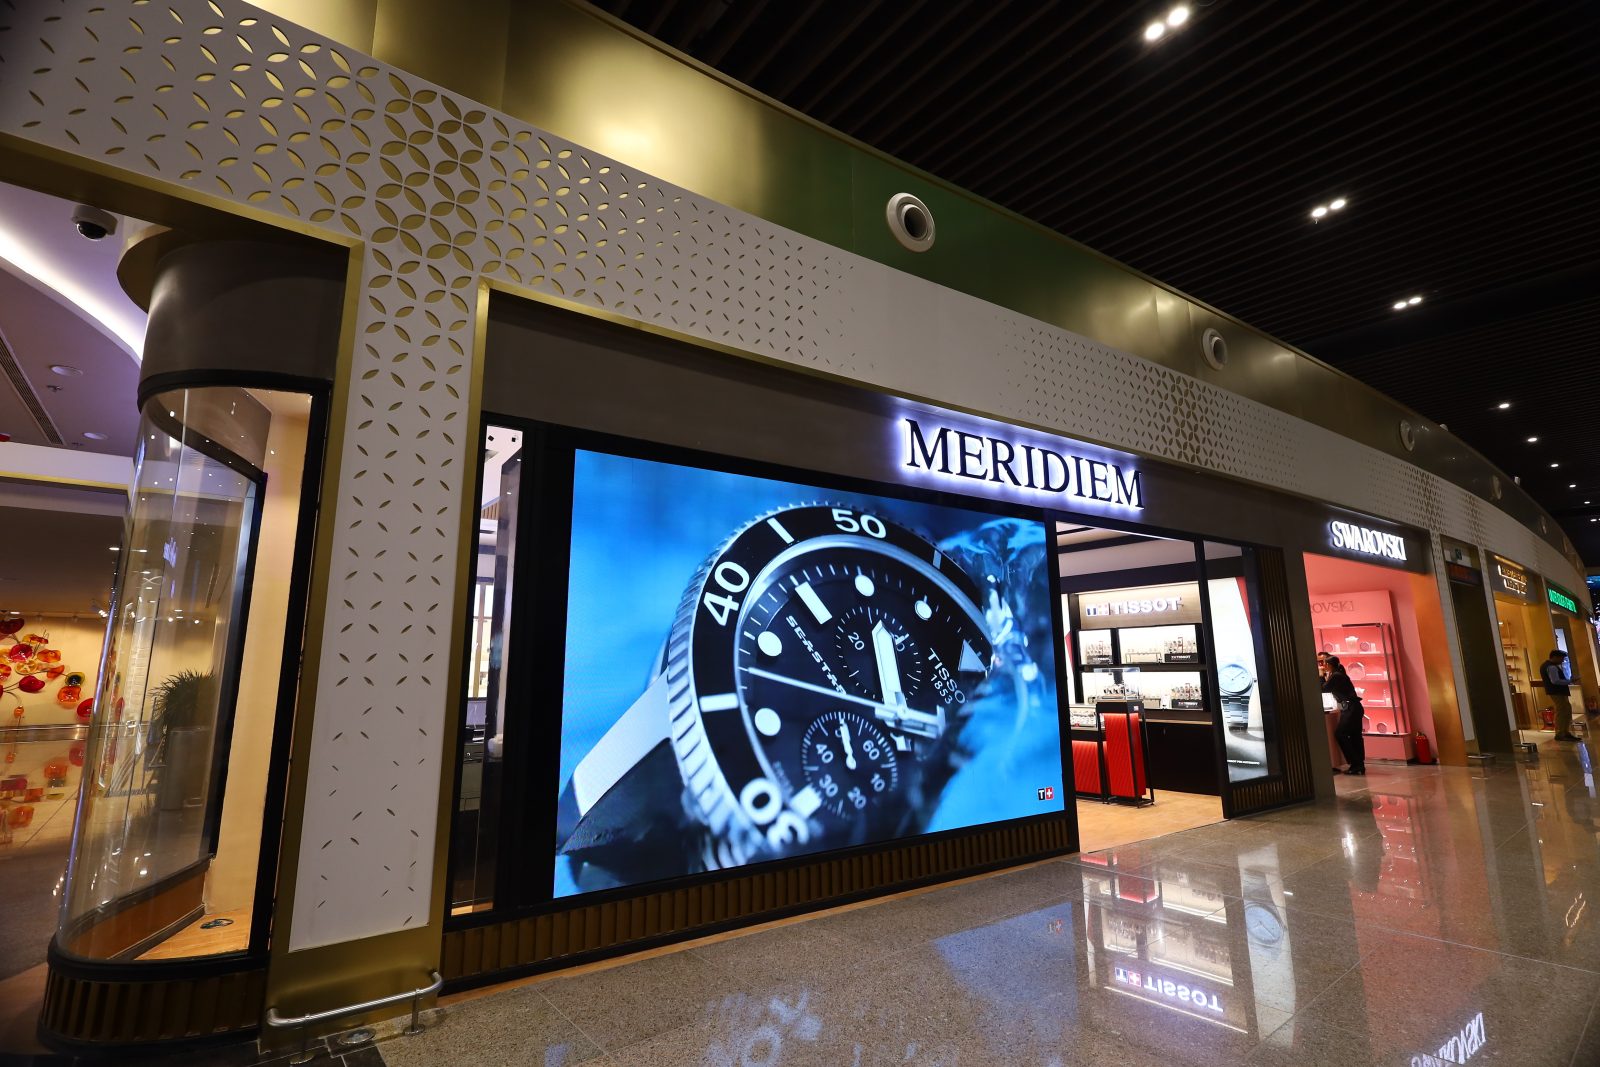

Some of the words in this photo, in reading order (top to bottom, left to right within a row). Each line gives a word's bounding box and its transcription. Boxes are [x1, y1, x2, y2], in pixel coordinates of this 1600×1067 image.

[904, 418, 1145, 510] MERIDIEM
[831, 508, 887, 539] 50
[1331, 520, 1408, 561] SWAROVSKI
[703, 561, 750, 626] 40
[1109, 597, 1181, 615] TISSOT
[847, 631, 865, 651] 20
[927, 647, 967, 704] TISSO
[930, 674, 953, 705] 1853
[815, 743, 834, 764] 40
[862, 739, 880, 761] 60
[819, 773, 839, 797] 30
[870, 772, 886, 792] 10
[847, 786, 867, 809] 20
